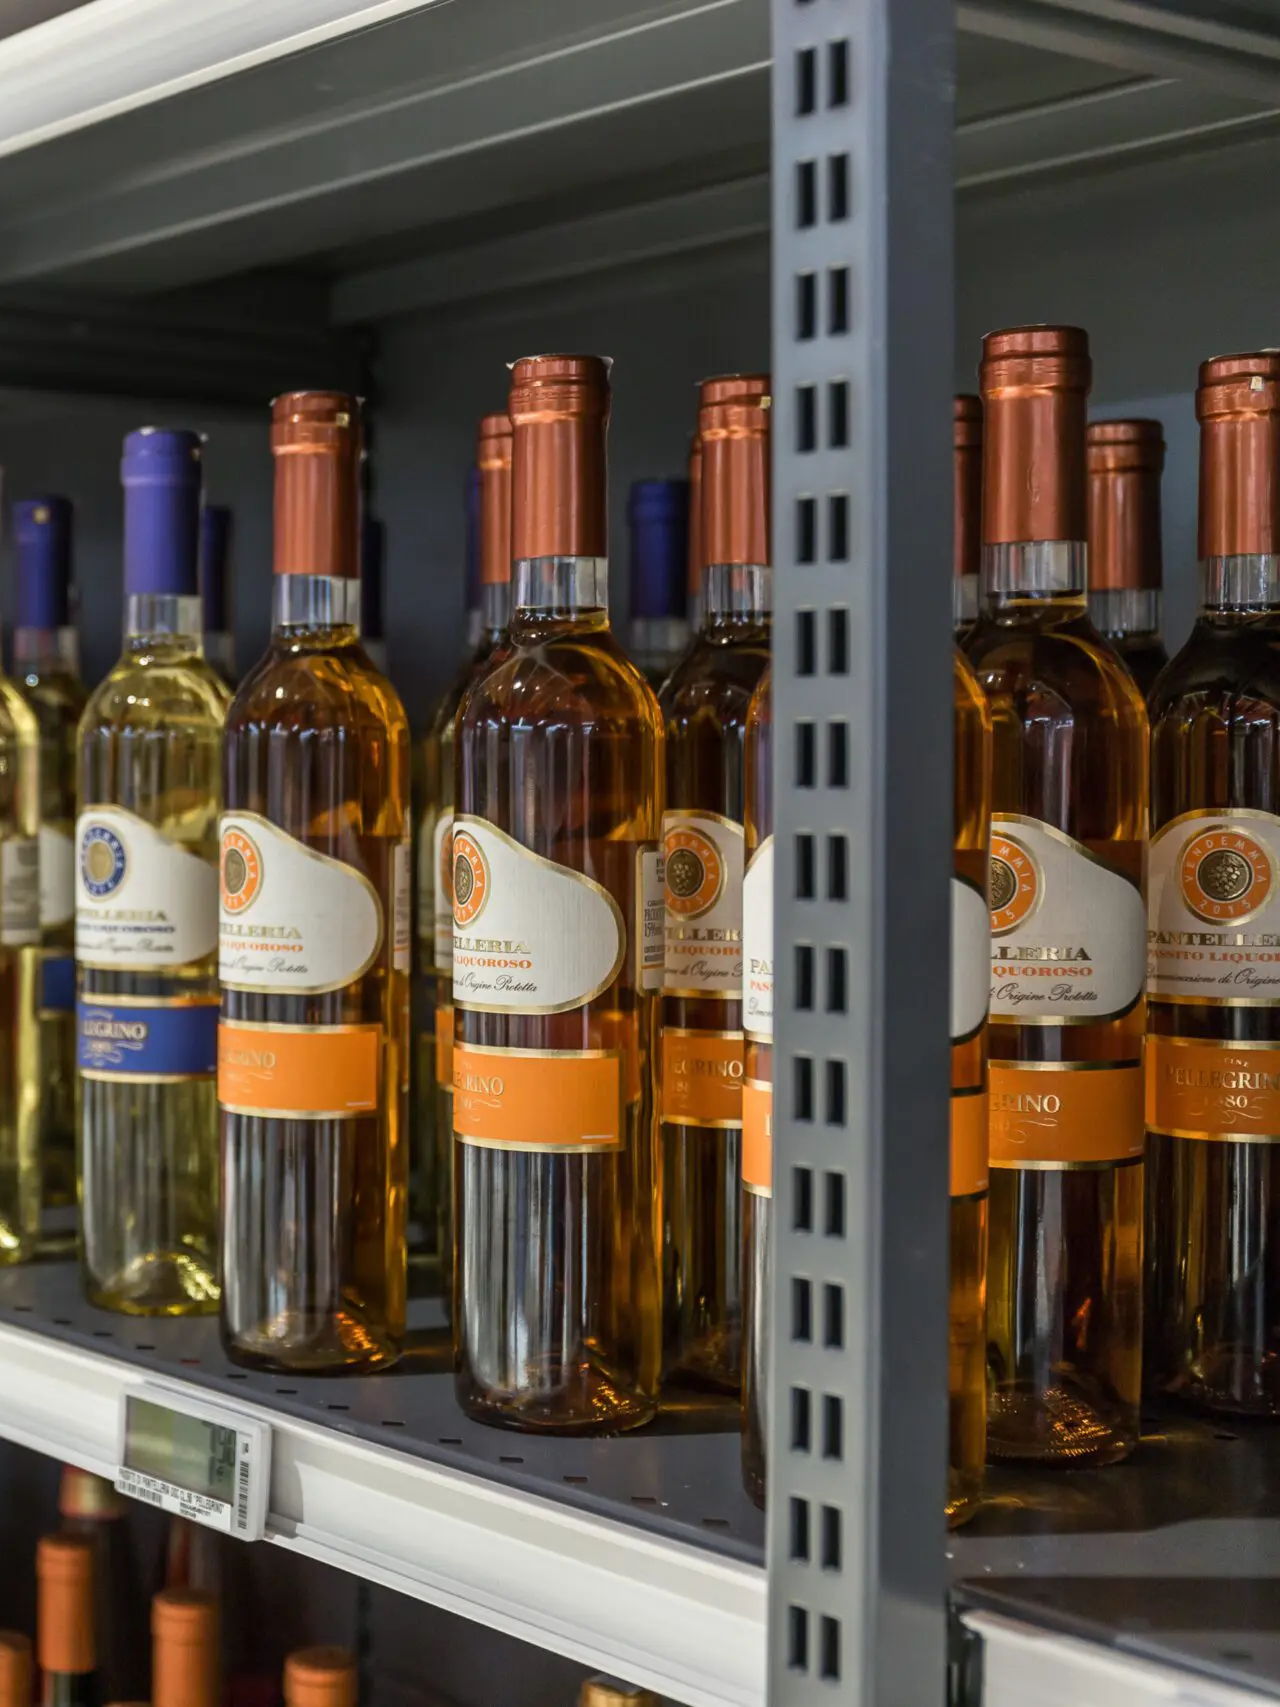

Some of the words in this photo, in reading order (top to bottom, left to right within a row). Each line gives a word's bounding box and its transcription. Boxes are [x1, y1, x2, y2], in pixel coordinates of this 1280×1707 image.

[998, 844, 1033, 893] MMIA
[1183, 836, 1268, 883] VENDEMMIA
[1199, 899, 1252, 915] 2015
[664, 927, 743, 943] ELLER
[454, 935, 532, 955] ELLERIA
[990, 946, 1093, 961] LERIA
[749, 958, 773, 975] PA
[992, 966, 1094, 979] QUOROSO
[494, 974, 538, 994] Protetta
[996, 982, 1045, 1005] Origine
